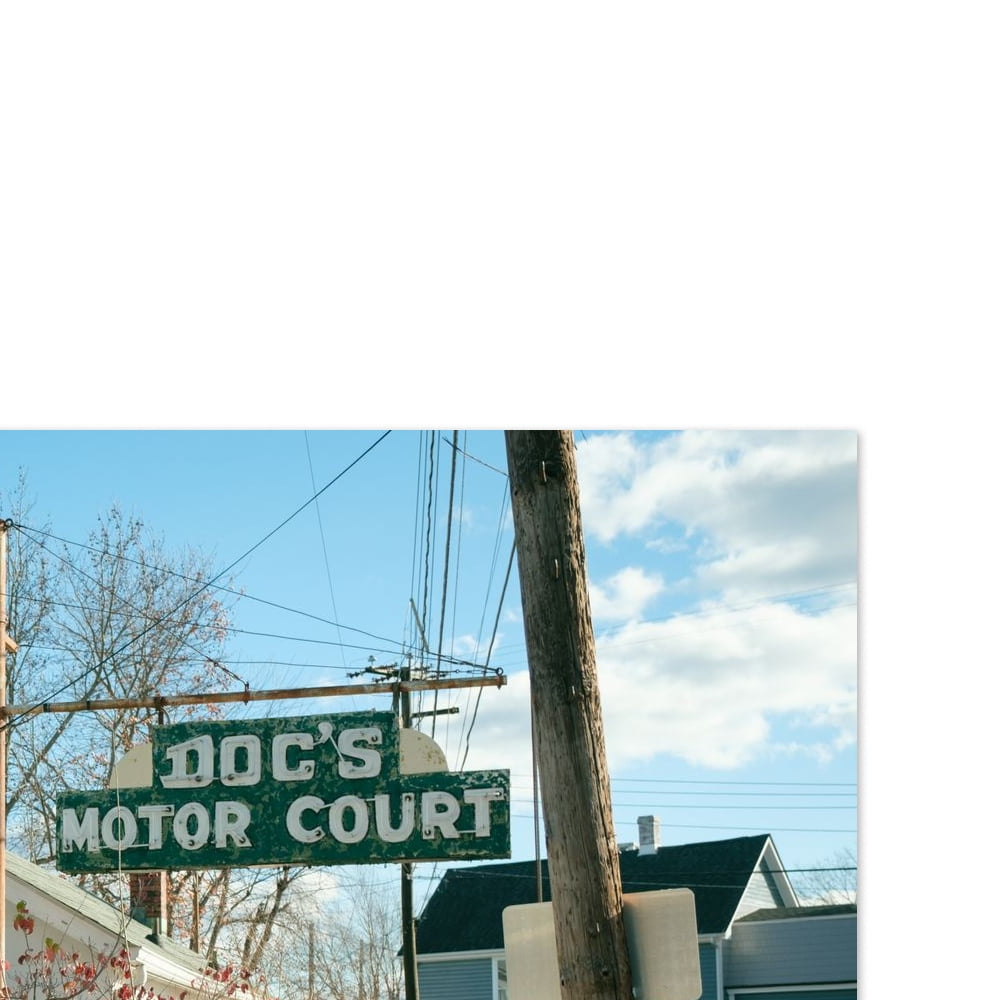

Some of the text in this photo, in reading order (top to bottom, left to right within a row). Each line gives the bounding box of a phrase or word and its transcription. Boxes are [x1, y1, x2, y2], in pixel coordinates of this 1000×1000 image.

[160, 722, 382, 789] DOC'S
[62, 788, 505, 853] MOTOR COURT
